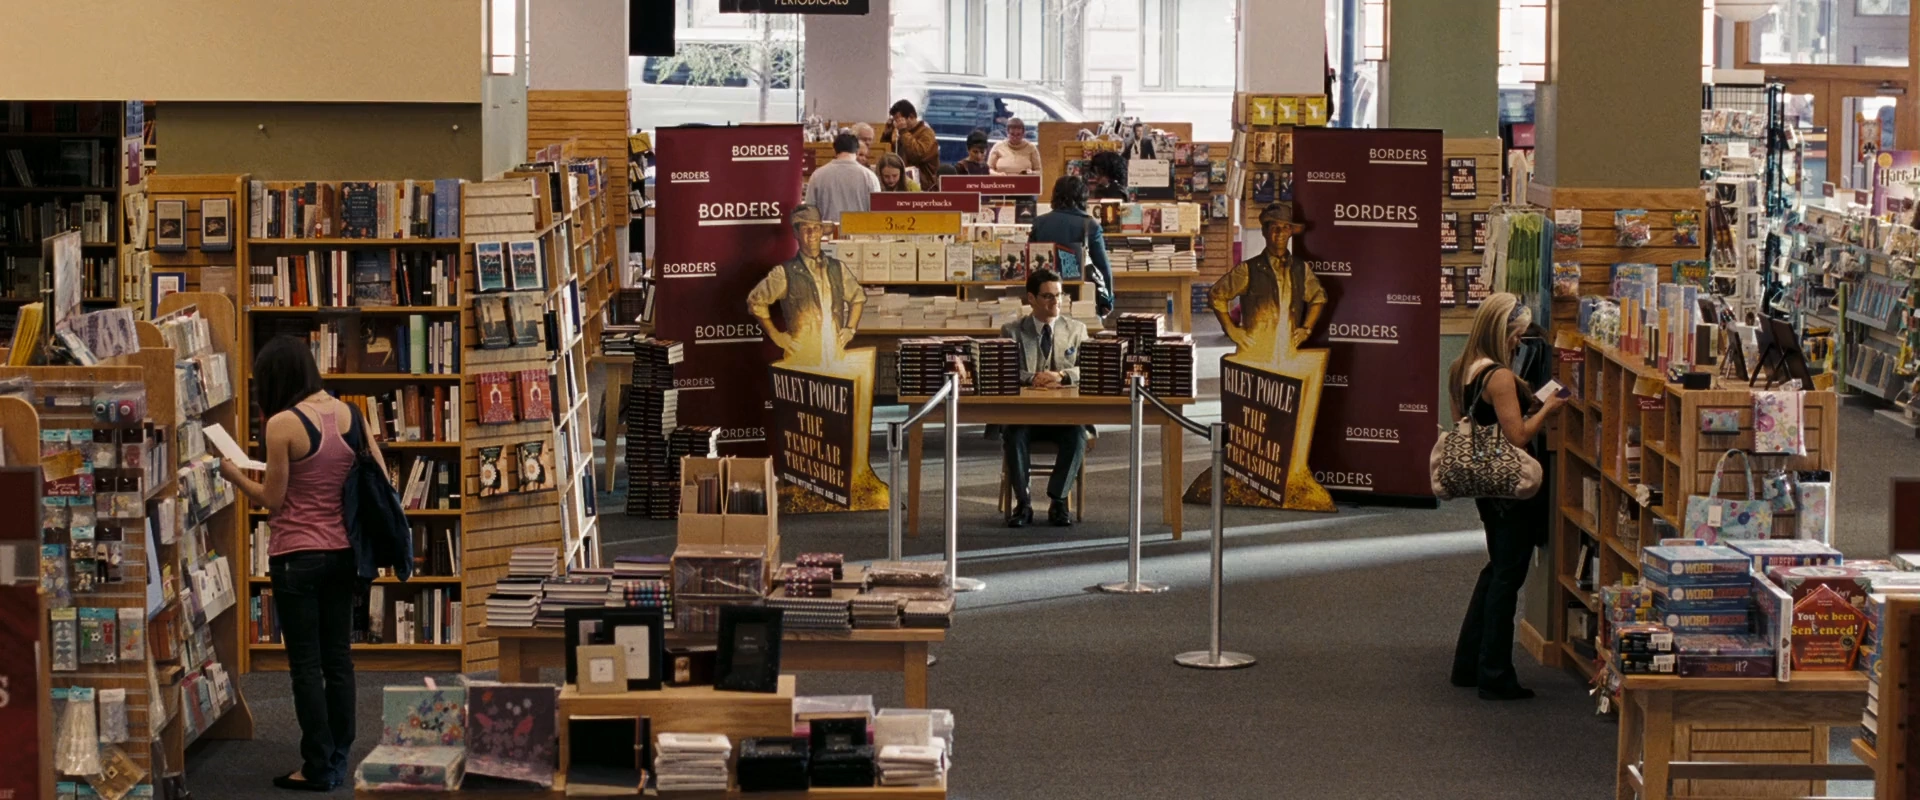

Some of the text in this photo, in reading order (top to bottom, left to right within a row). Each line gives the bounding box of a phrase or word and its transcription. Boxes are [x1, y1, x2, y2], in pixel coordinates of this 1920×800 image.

[732, 145, 789, 157] BORDERS
[1369, 148, 1427, 160] BORDERS
[671, 171, 710, 180] BORDERS
[1307, 171, 1346, 180] BORDERS
[980, 181, 1015, 189] hardcovers
[912, 199, 952, 208] paperbacks
[698, 202, 782, 219] BORDERS
[1333, 204, 1418, 220] BORDERS
[884, 215, 893, 230] 3
[907, 215, 916, 230] 2
[664, 262, 716, 274] BORDERS
[1307, 260, 1352, 271] ORDERS
[1386, 294, 1421, 303] BORDERS
[695, 323, 763, 338] BORDERS
[1329, 323, 1398, 338] BORDERS
[673, 377, 715, 387] BORDERS
[1324, 374, 1348, 383] DERS
[773, 373, 849, 415] RILEY POOLE
[1224, 366, 1254, 399] RILEY
[1256, 375, 1296, 413] POOLE
[1399, 403, 1428, 411] BORDERS
[797, 411, 823, 438] THE
[1242, 405, 1267, 434] THE
[718, 427, 765, 438] ORDERS
[1346, 426, 1399, 439] BORDERS
[784, 430, 840, 466] TEMPLAR
[1228, 421, 1281, 463] TEMPLAR
[784, 450, 844, 488] TREASURE
[1225, 442, 1281, 485] TREASURE
[1314, 470, 1373, 485] ORDERS
[1685, 563, 1713, 574] WORD
[1685, 588, 1714, 600] WORD
[1681, 615, 1710, 627] WORD
[1797, 611, 1855, 621] You've been
